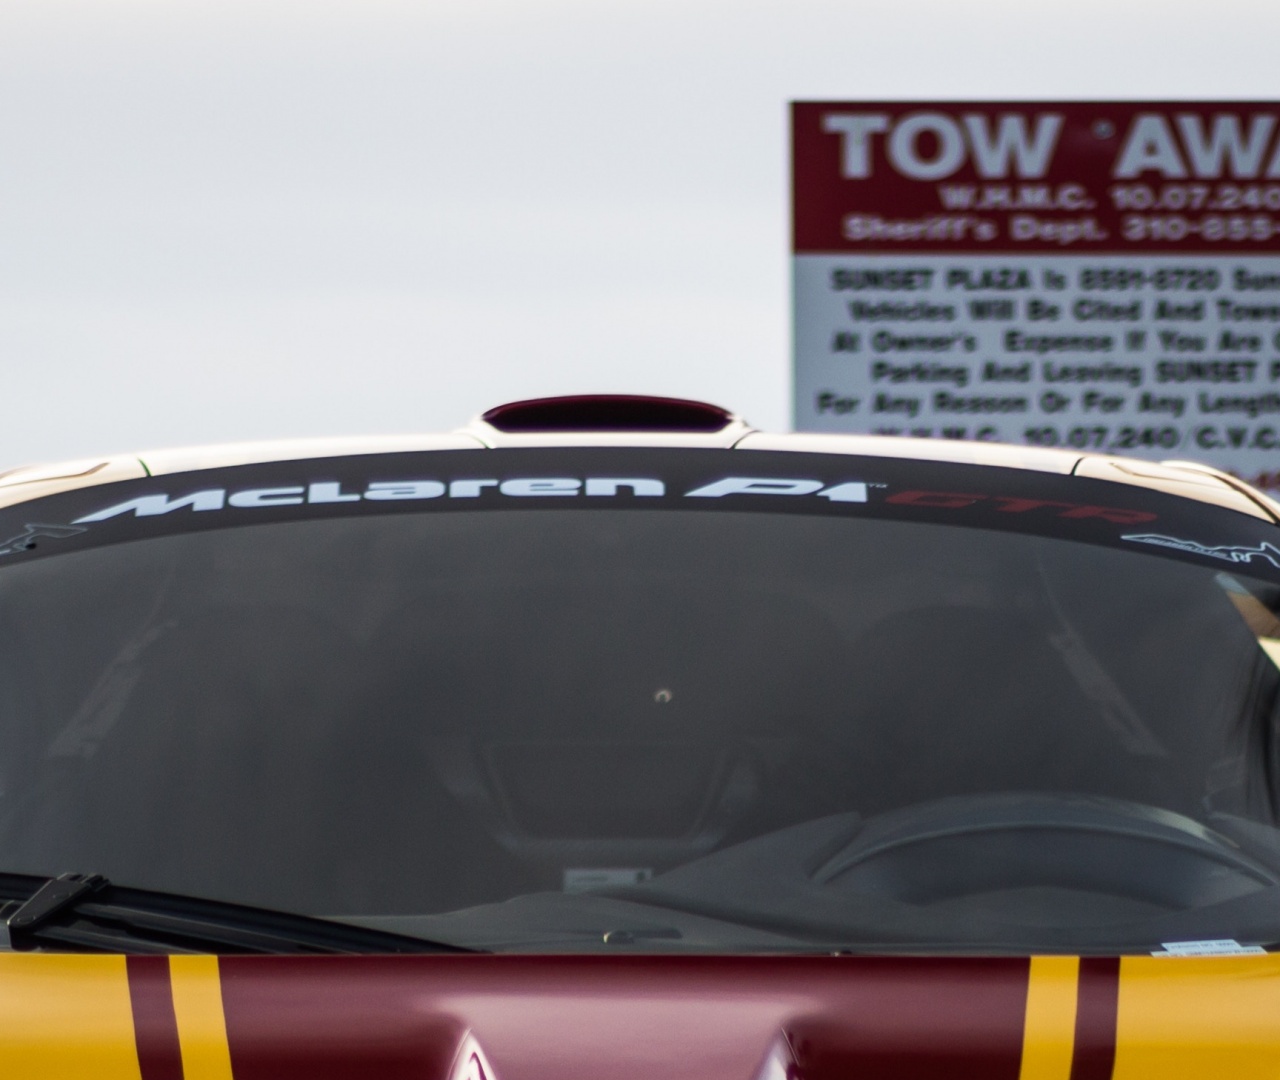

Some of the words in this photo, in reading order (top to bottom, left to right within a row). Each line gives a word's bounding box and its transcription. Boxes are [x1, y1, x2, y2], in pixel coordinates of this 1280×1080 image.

[823, 114, 1065, 182] TOW
[938, 184, 1095, 211] W.H.M.C.
[842, 213, 998, 242] Sheriff's
[1008, 214, 1108, 246] Dept.
[830, 267, 936, 292] SUNSET
[944, 267, 1033, 292] PLAZA
[847, 298, 958, 323] Vehicles
[966, 298, 1017, 322] Will
[1024, 297, 1062, 323] Be
[1071, 298, 1143, 323] Cited
[1152, 298, 1207, 323] And
[830, 330, 862, 354] At
[869, 330, 979, 354] Owner's
[1002, 328, 1117, 356] Expense
[1124, 328, 1149, 352] If
[1157, 328, 1208, 353] You
[1216, 329, 1264, 353] Are
[870, 360, 972, 388] Parking
[979, 360, 1034, 384] And
[1040, 361, 1146, 389] Leaving
[1153, 359, 1259, 384] SUNSET
[814, 390, 861, 416] For
[871, 391, 923, 418] Any
[930, 389, 1031, 415] Reason
[1038, 389, 1073, 415] Or
[1080, 389, 1127, 415] For
[1137, 390, 1188, 419] Any
[70, 478, 665, 525] McLaren
[884, 489, 1160, 526] GTR
